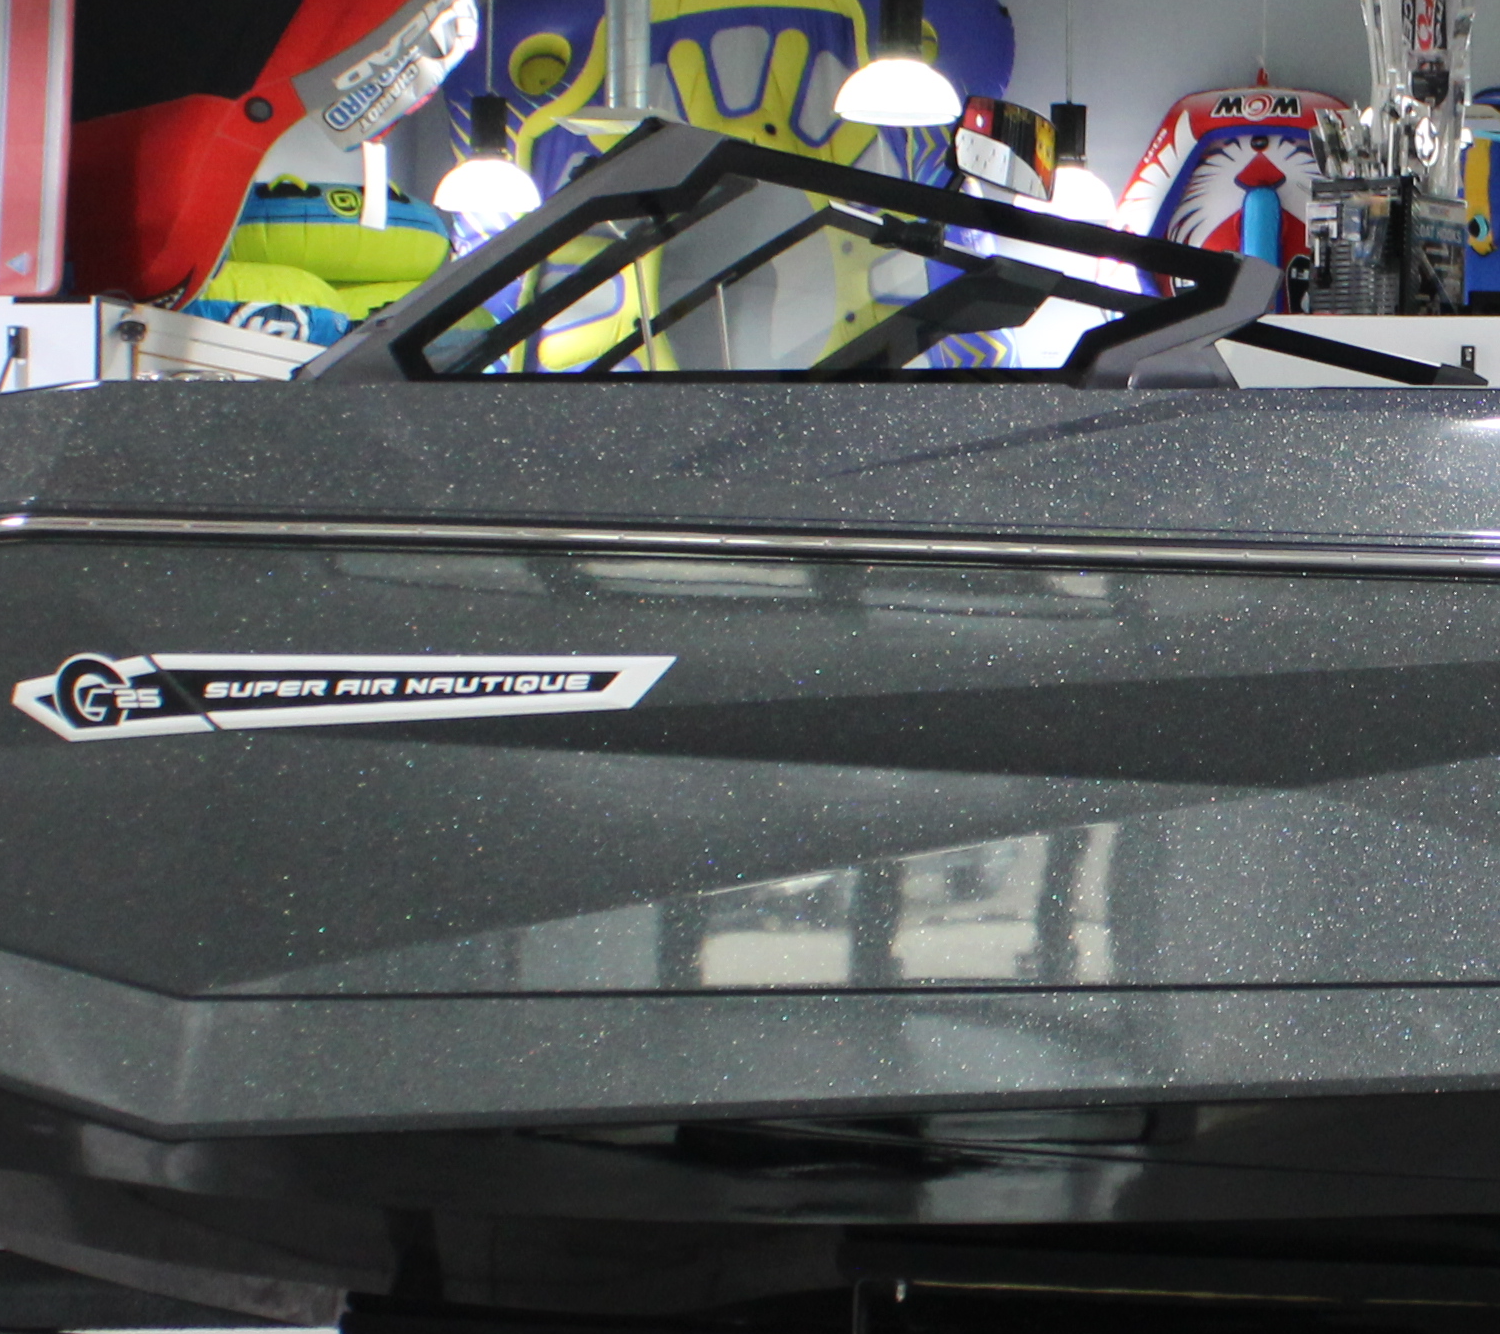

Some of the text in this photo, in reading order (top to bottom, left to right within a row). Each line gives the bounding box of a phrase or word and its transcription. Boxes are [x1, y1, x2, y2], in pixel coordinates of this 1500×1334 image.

[203, 677, 328, 699] SUPER
[334, 676, 396, 697] AIR
[404, 673, 592, 695] NAUTIQUE
